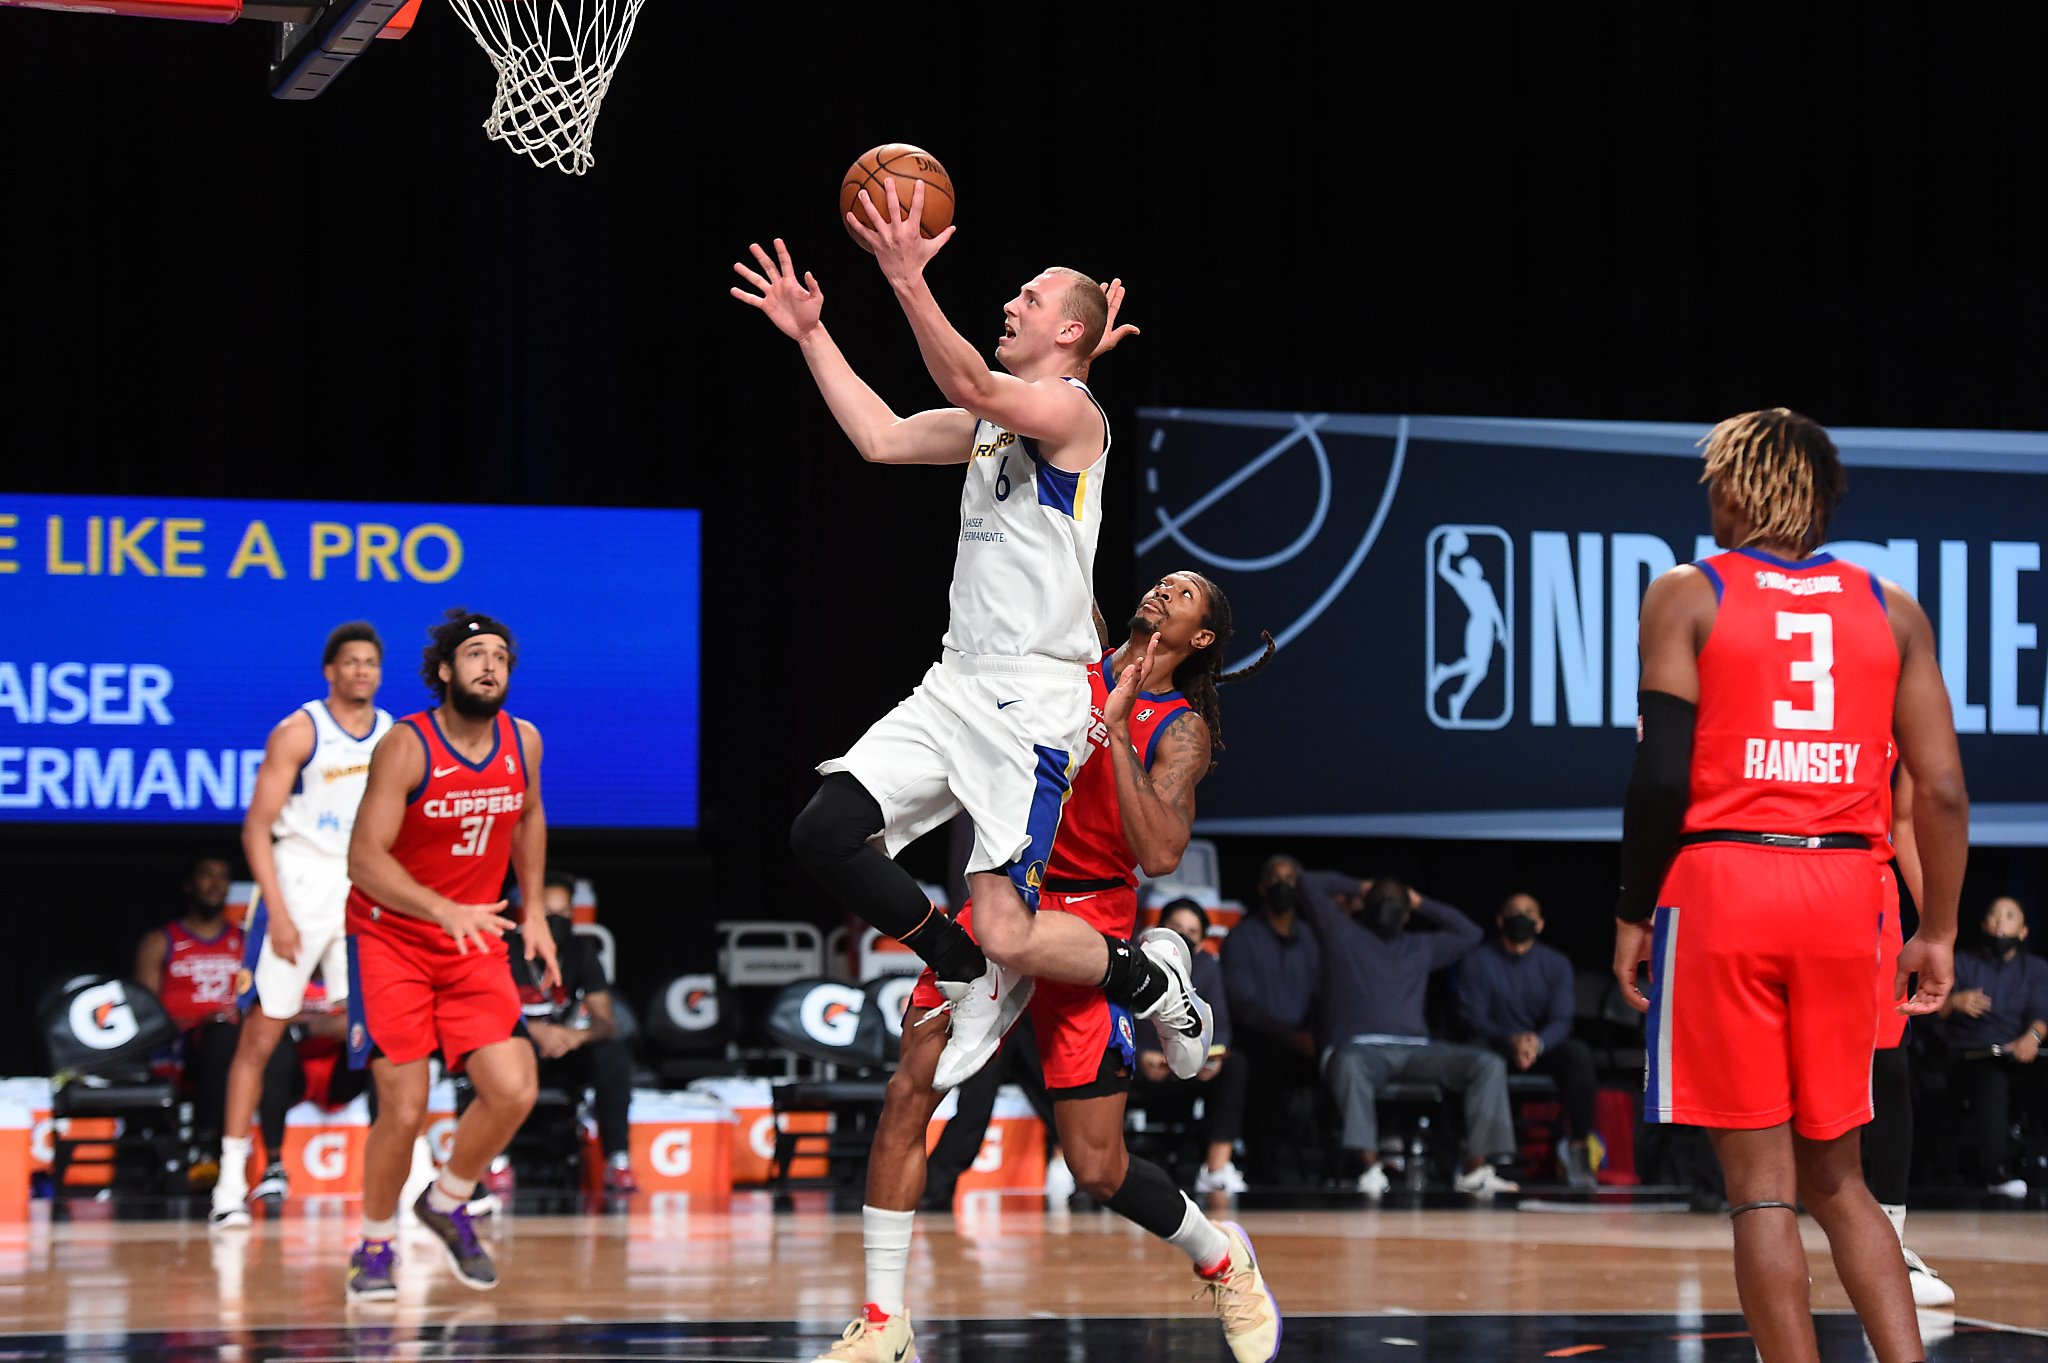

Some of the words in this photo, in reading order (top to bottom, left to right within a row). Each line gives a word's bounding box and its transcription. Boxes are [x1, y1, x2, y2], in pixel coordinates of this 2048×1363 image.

[995, 456, 1011, 501] 6
[47, 514, 206, 578] LIKE
[226, 519, 287, 580] A
[309, 522, 464, 585] PRO
[1939, 539, 2048, 734] LE
[1773, 611, 1835, 731] 3
[1744, 738, 1861, 784] RAMSEY
[423, 792, 524, 818] CLIPPERS
[451, 815, 495, 856] 31
[69, 980, 139, 1049] G
[665, 973, 719, 1031] G
[801, 983, 865, 1047] G
[303, 1132, 347, 1181] G
[650, 1129, 692, 1176] G
